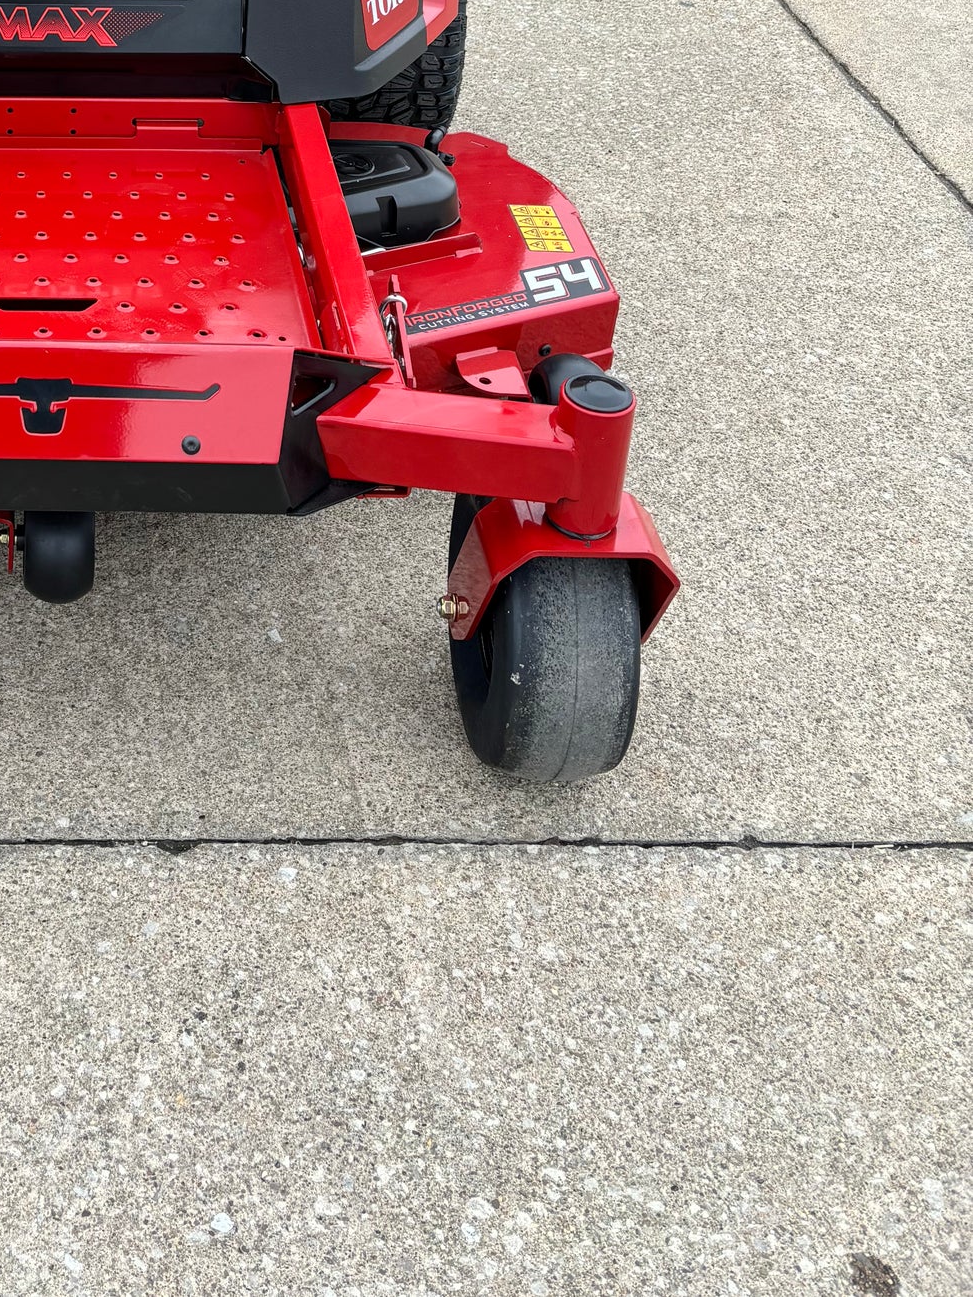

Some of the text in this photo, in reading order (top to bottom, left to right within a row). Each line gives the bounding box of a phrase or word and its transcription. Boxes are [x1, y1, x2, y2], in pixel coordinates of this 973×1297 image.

[523, 258, 605, 304] 54
[405, 292, 528, 327] IRONFORGED
[418, 301, 530, 331] CUTTING SYSTEM
